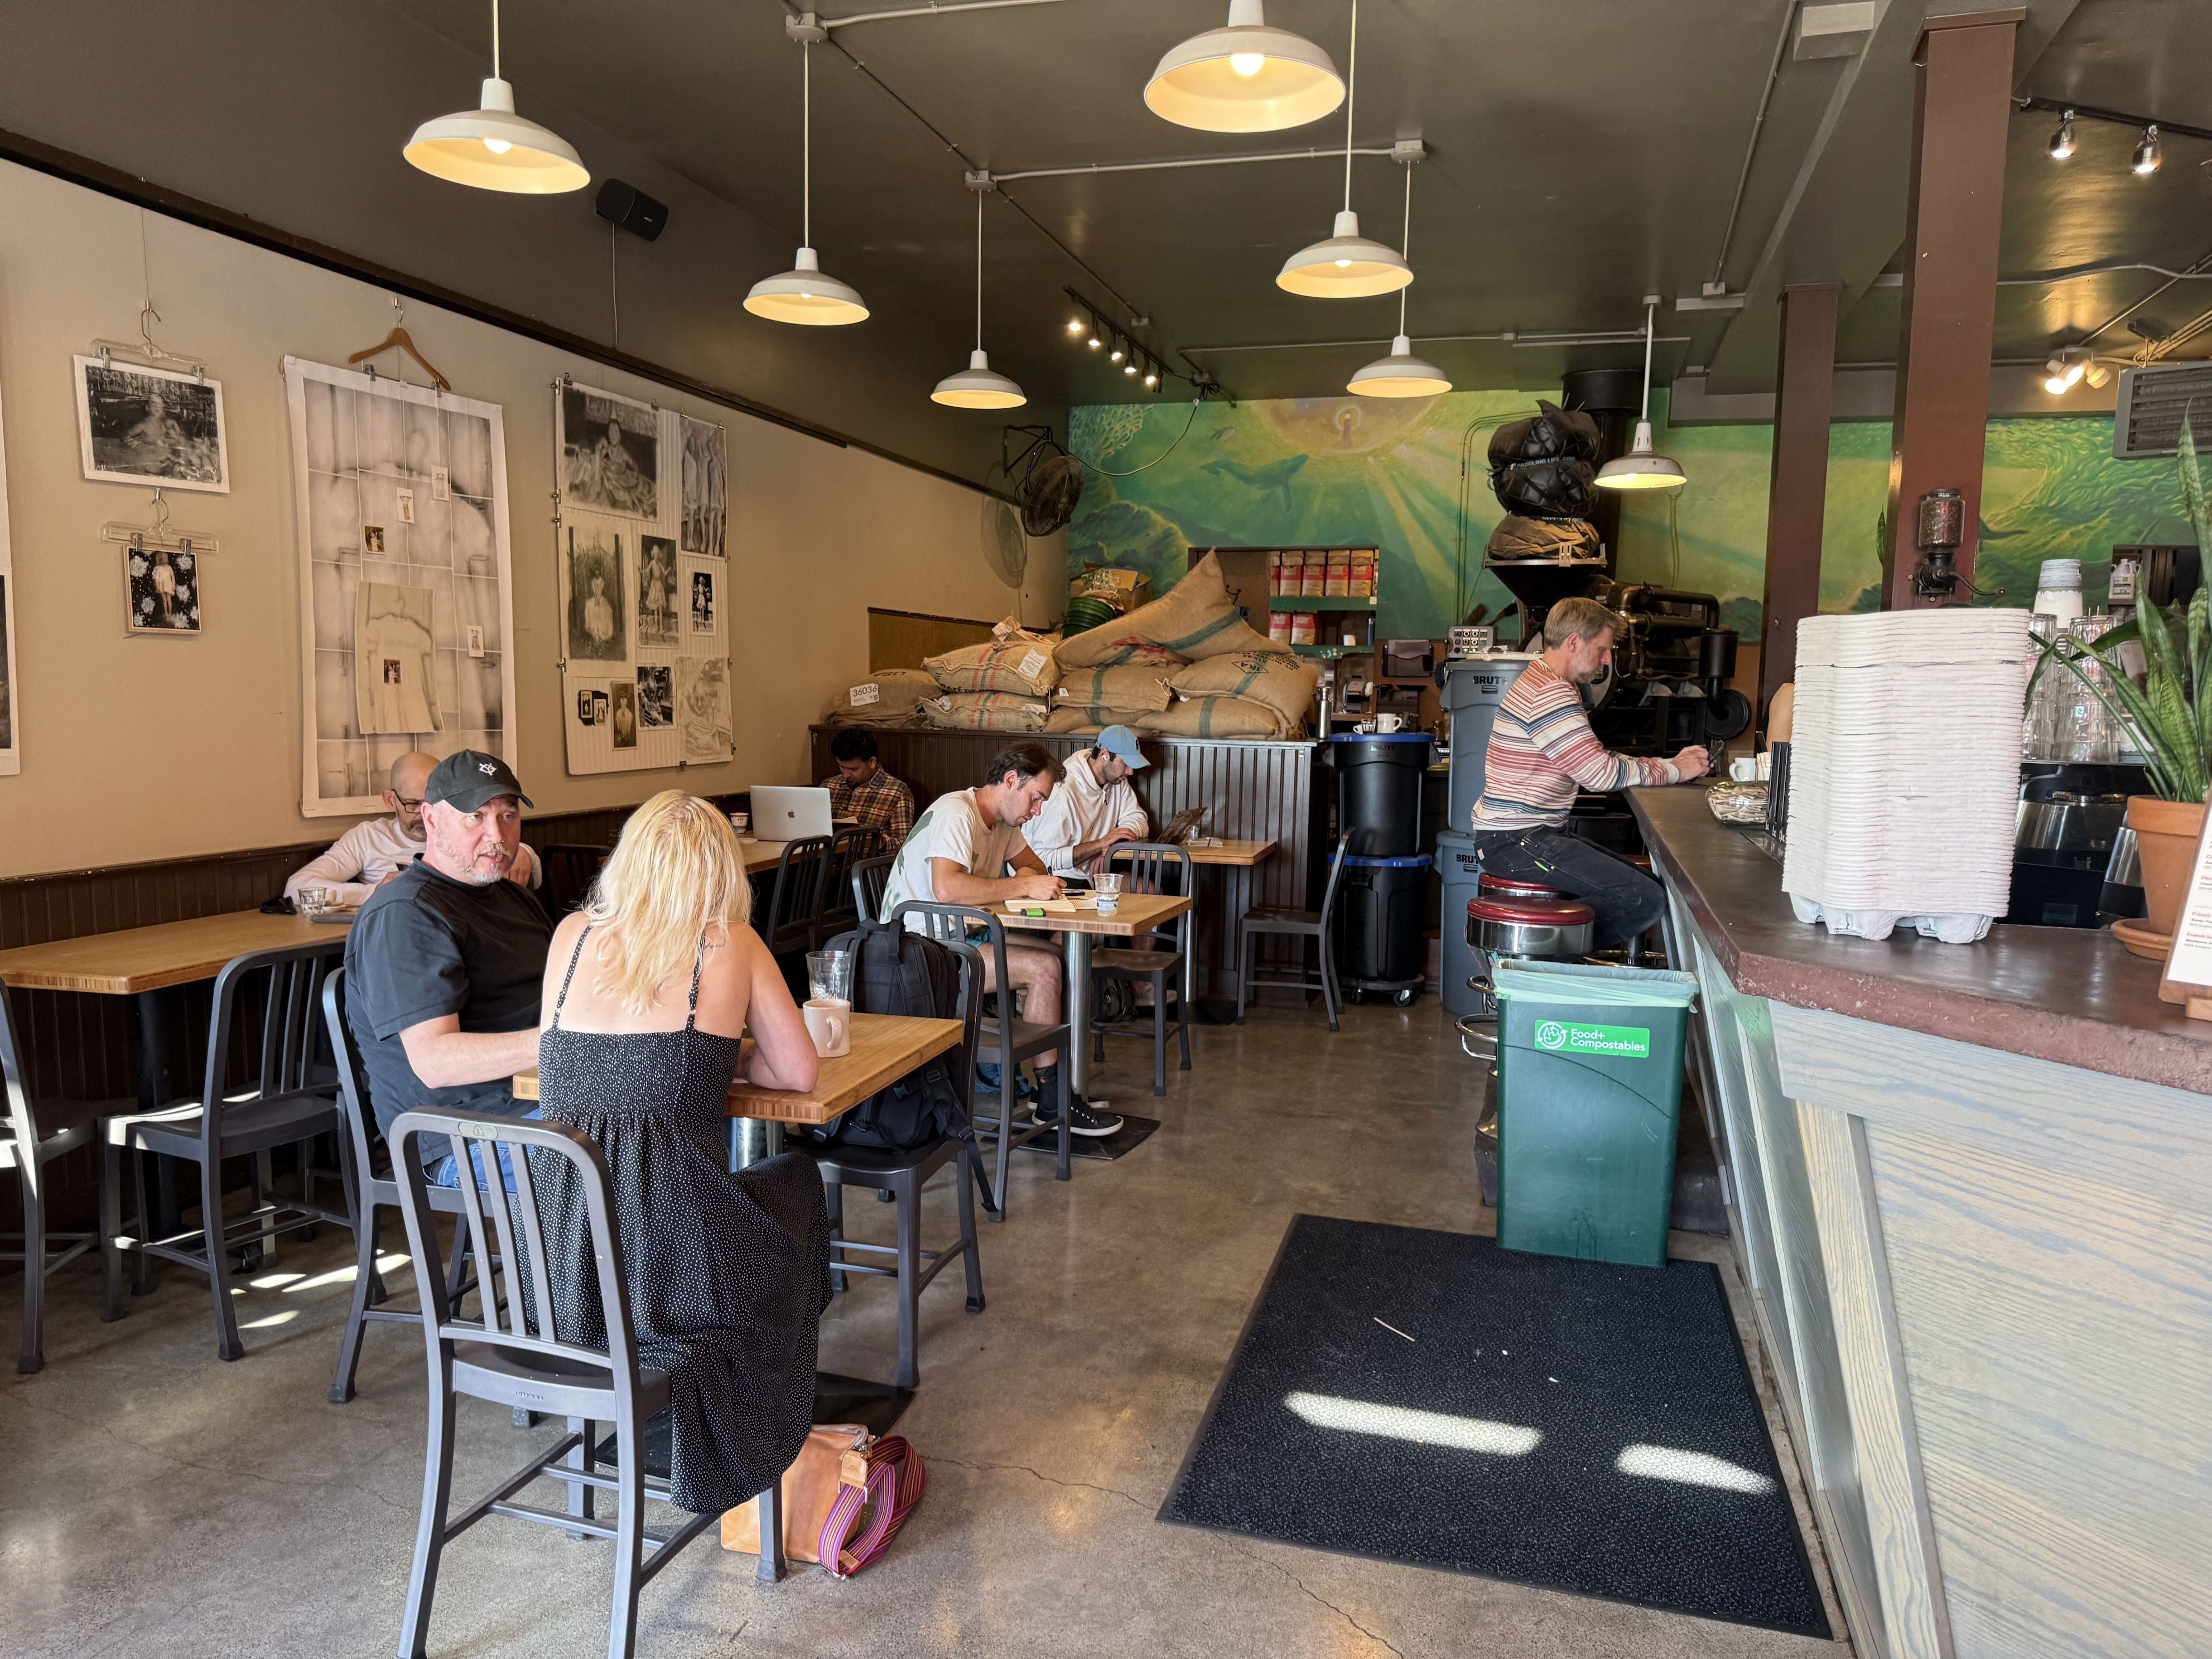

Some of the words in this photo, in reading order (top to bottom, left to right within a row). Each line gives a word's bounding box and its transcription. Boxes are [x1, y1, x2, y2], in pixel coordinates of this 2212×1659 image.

[853, 686, 878, 697] 36036
[1571, 1029, 1604, 1039] Food+
[1570, 1037, 1645, 1052] Compostables
